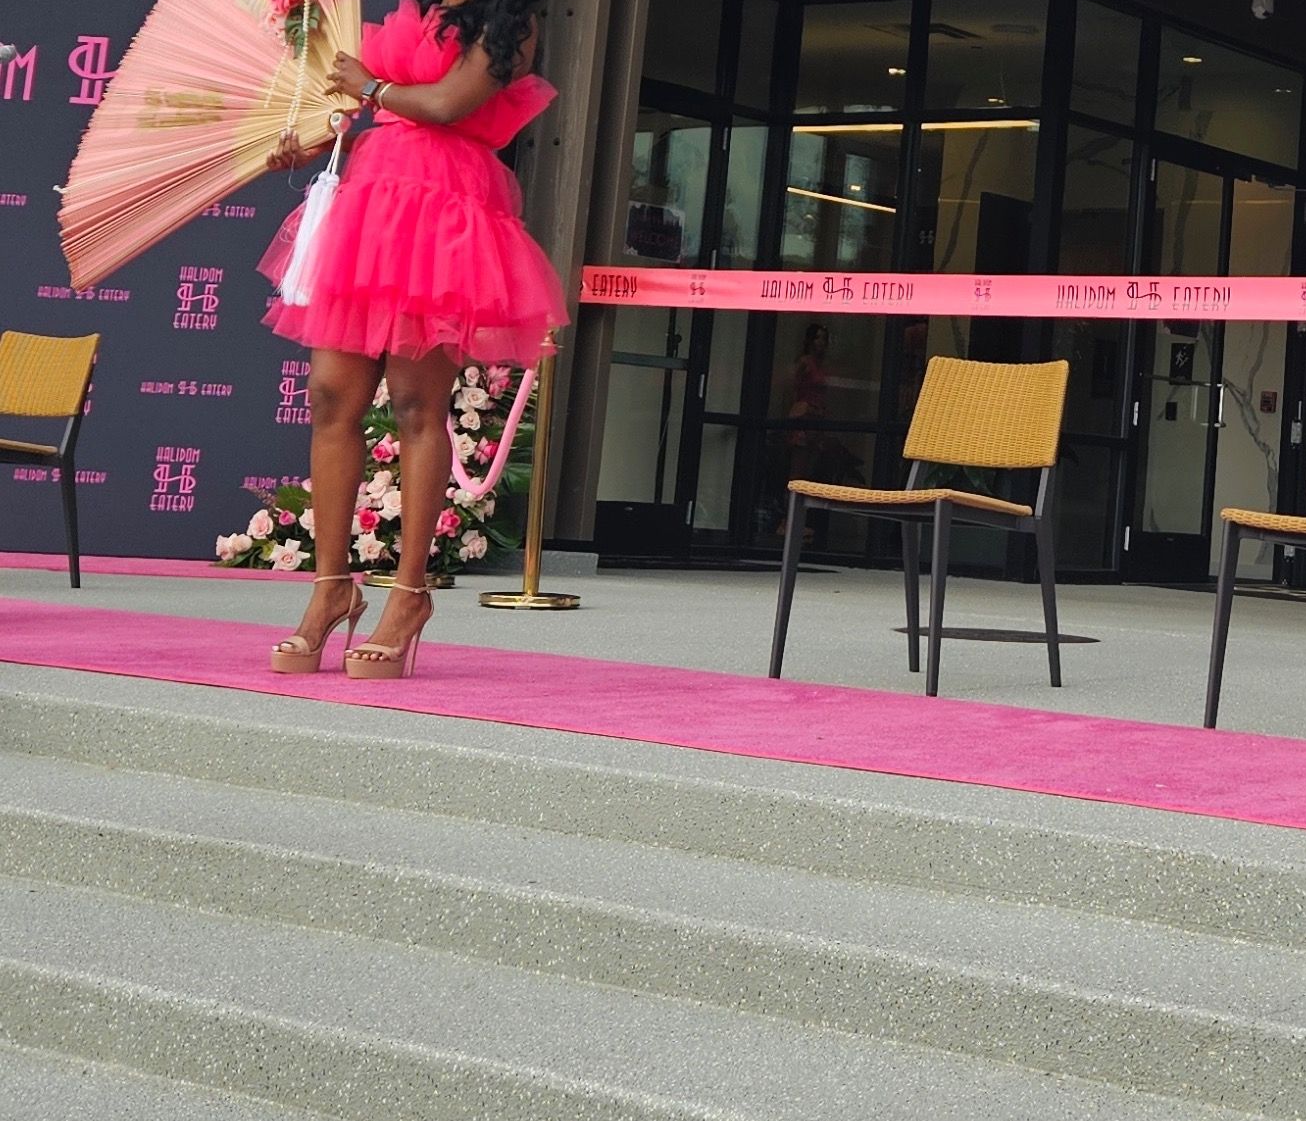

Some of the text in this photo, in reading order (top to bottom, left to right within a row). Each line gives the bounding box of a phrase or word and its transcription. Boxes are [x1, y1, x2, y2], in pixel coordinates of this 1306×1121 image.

[0, 193, 27, 207] ATERY
[224, 205, 256, 218] EATERY
[179, 266, 223, 283] HALIDOM
[37, 286, 71, 299] HALIDOM
[98, 288, 131, 302] EATERY
[592, 274, 637, 298] EATERY
[1056, 285, 1116, 309] HALIDOM
[1172, 286, 1231, 311] EATERY
[173, 313, 218, 330] EATERY
[281, 360, 311, 376] HALID
[140, 381, 174, 394] HALIDOM
[201, 383, 233, 397] EATERY
[275, 408, 311, 424] EATER
[156, 446, 200, 463] HALIDOM
[13, 468, 47, 481] HALIDOM
[75, 470, 107, 484] EATERY
[243, 477, 276, 489] HALIDOM
[150, 494, 195, 512] EATERY
